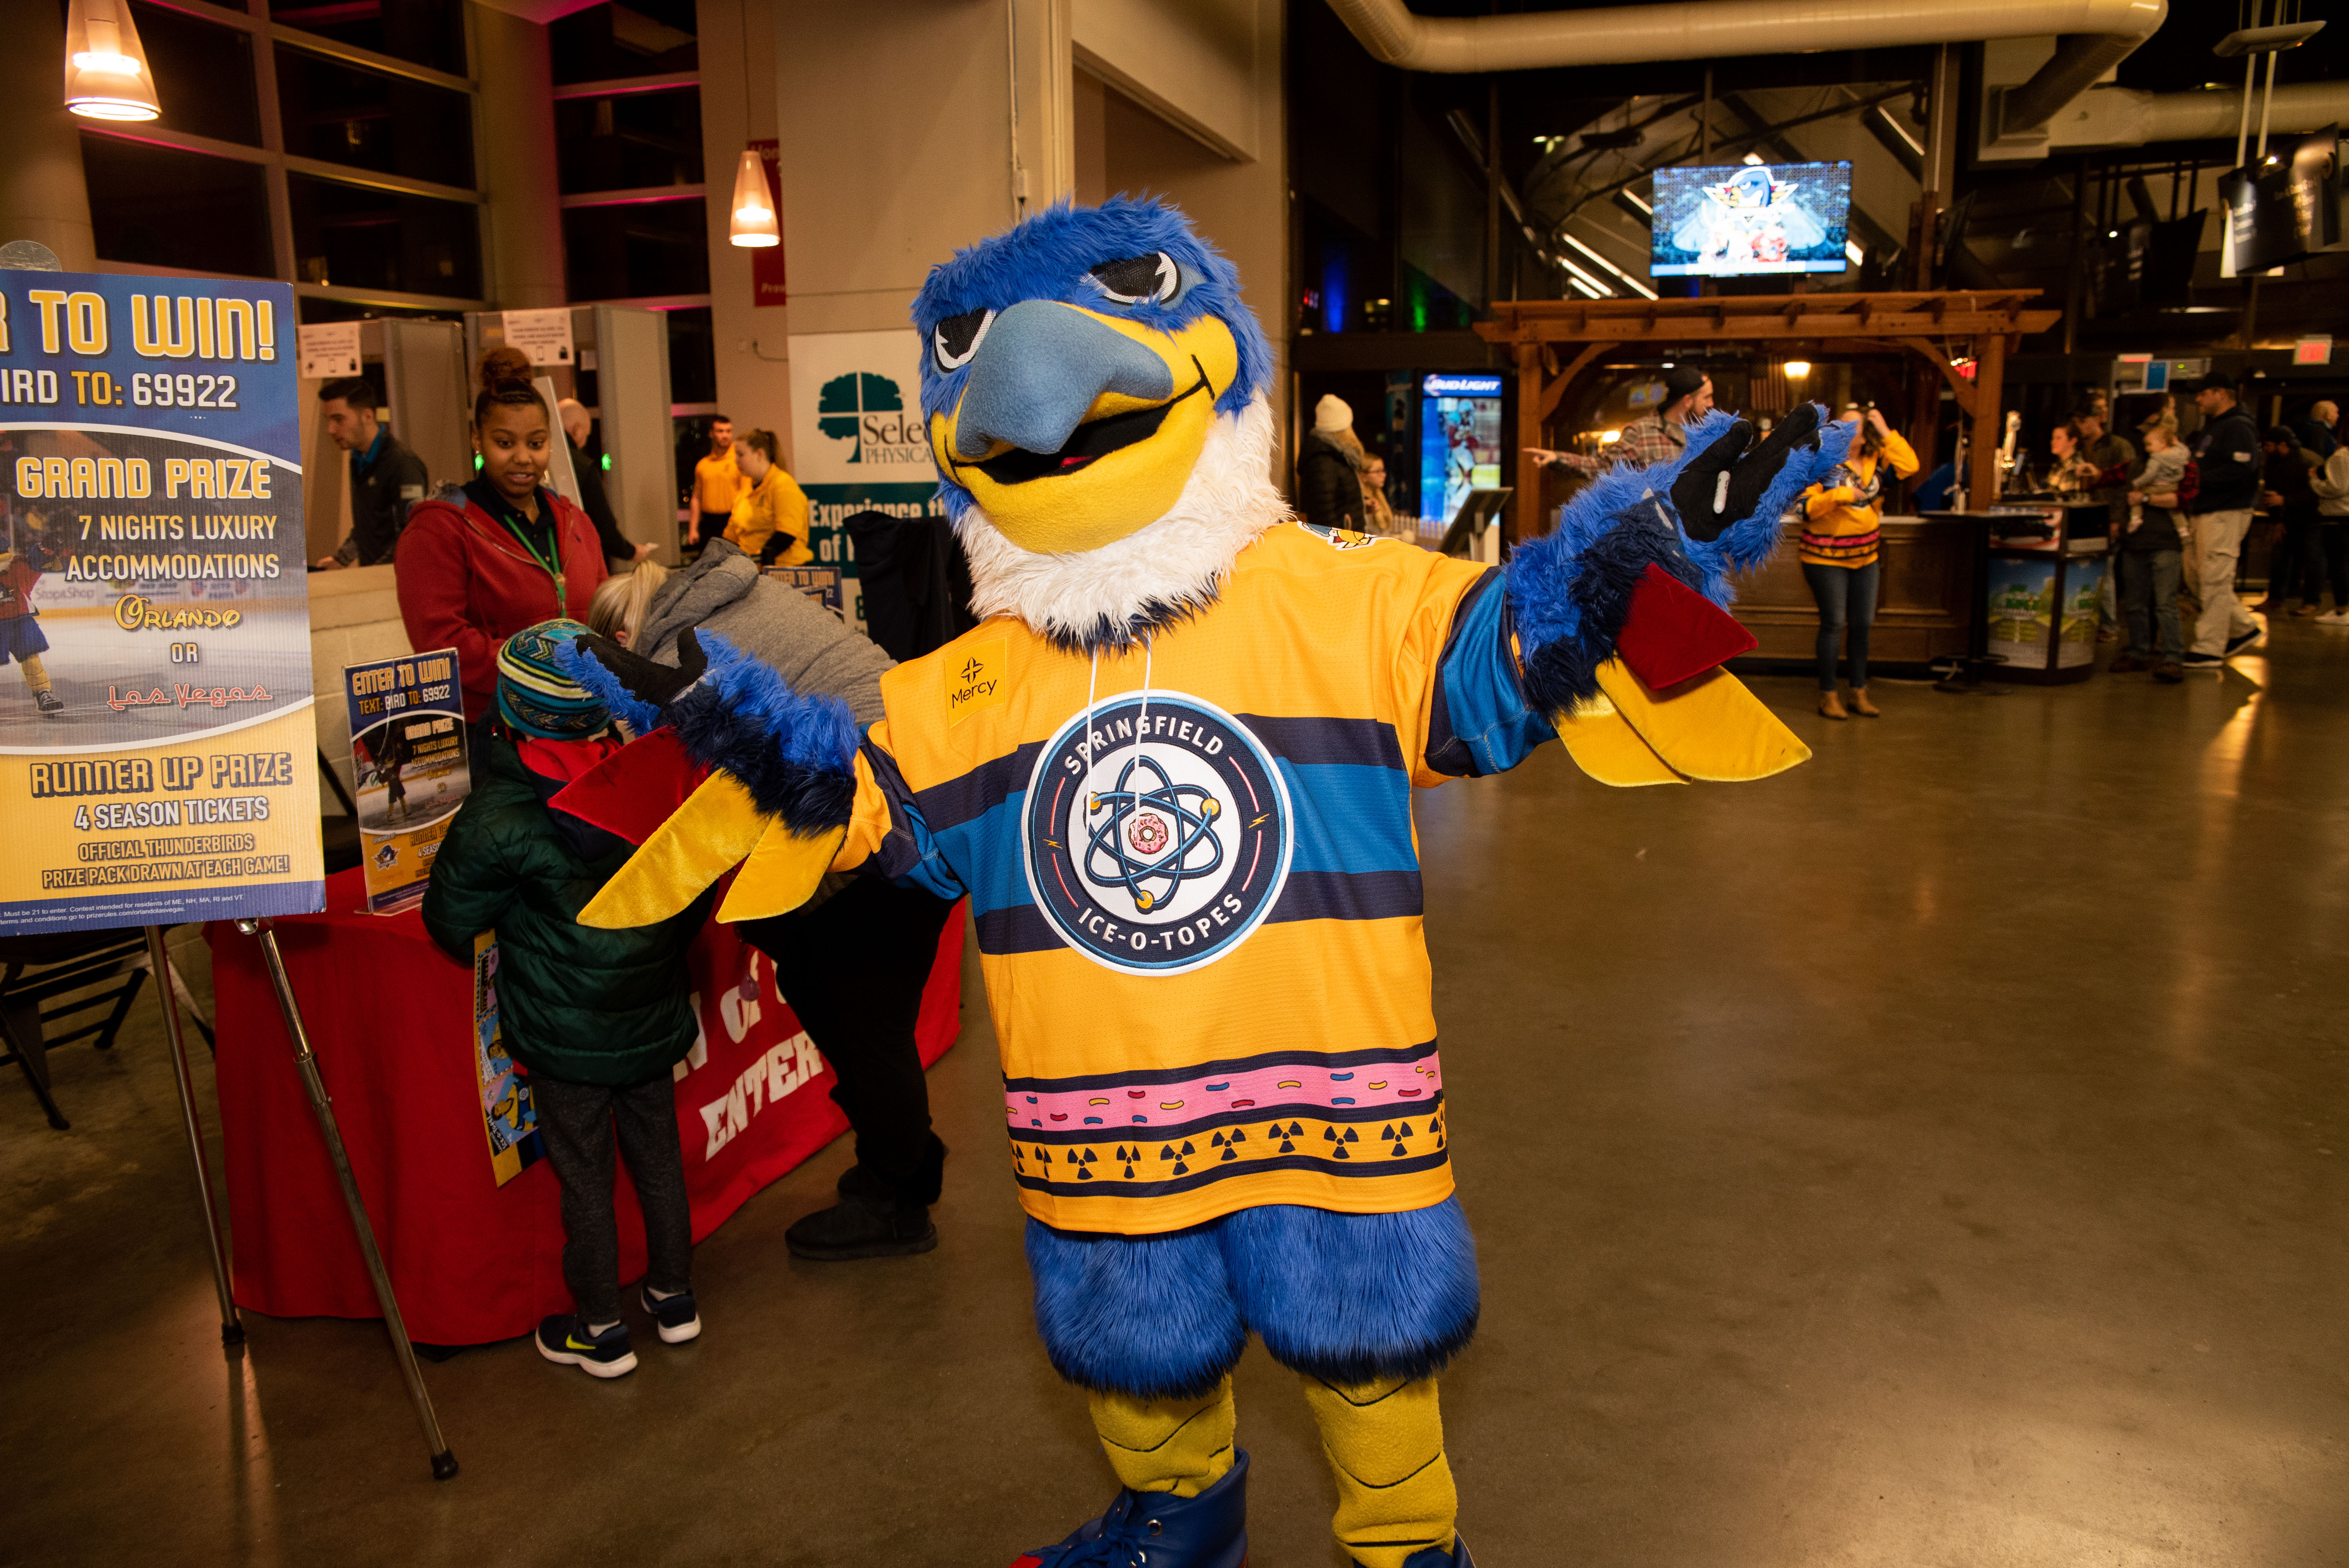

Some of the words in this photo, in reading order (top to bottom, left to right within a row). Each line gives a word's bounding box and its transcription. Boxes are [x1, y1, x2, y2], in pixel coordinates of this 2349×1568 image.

[29, 290, 108, 355] TO
[131, 294, 275, 361] WIN!
[71, 371, 122, 405] TO:
[132, 373, 237, 408] 69922
[16, 457, 151, 499] GRAND
[165, 459, 271, 499] PRIZE
[78, 515, 91, 540] 7
[101, 515, 184, 540] NIGHTS
[192, 515, 277, 540] LUXURY
[819, 534, 841, 562] of
[66, 554, 280, 580] ACCOMMODATIONS
[170, 642, 198, 663] OR
[352, 667, 395, 696] ENTER
[397, 663, 415, 687] TO
[418, 657, 451, 684] WIN!
[107, 684, 171, 710] Las
[174, 682, 273, 708] Vegas
[358, 697, 384, 715] TEXT:
[385, 692, 406, 710] BIRD
[407, 690, 422, 706] TO:
[422, 684, 451, 703] 69922
[952, 677, 998, 709] Mercy
[405, 722, 431, 740] GRAND
[432, 717, 454, 734] PRIZE
[411, 748, 460, 768] ACCOMMODATIONS
[412, 745, 416, 755] 7
[417, 740, 437, 754] NIGHTS
[437, 736, 458, 749] LUXURY
[1064, 716, 1224, 775] SPRINGFIELD
[30, 759, 153, 798] RUNNER
[160, 756, 204, 791] UP
[210, 752, 292, 789] PRIZE
[74, 805, 89, 831] 4
[94, 800, 180, 829] SEASON
[184, 796, 269, 823] TICKETS
[78, 840, 144, 862] OFFICIAL
[146, 833, 254, 858] THUNDERBIRDS
[418, 847, 422, 858] 4
[42, 869, 85, 889] PRIZE
[89, 866, 129, 886] PACK
[130, 862, 182, 884] DRAWN
[184, 861, 203, 878] AT
[205, 858, 242, 877] EACH
[244, 855, 290, 874] GAME!
[1078, 893, 1242, 951] ICE-O-TOPES
